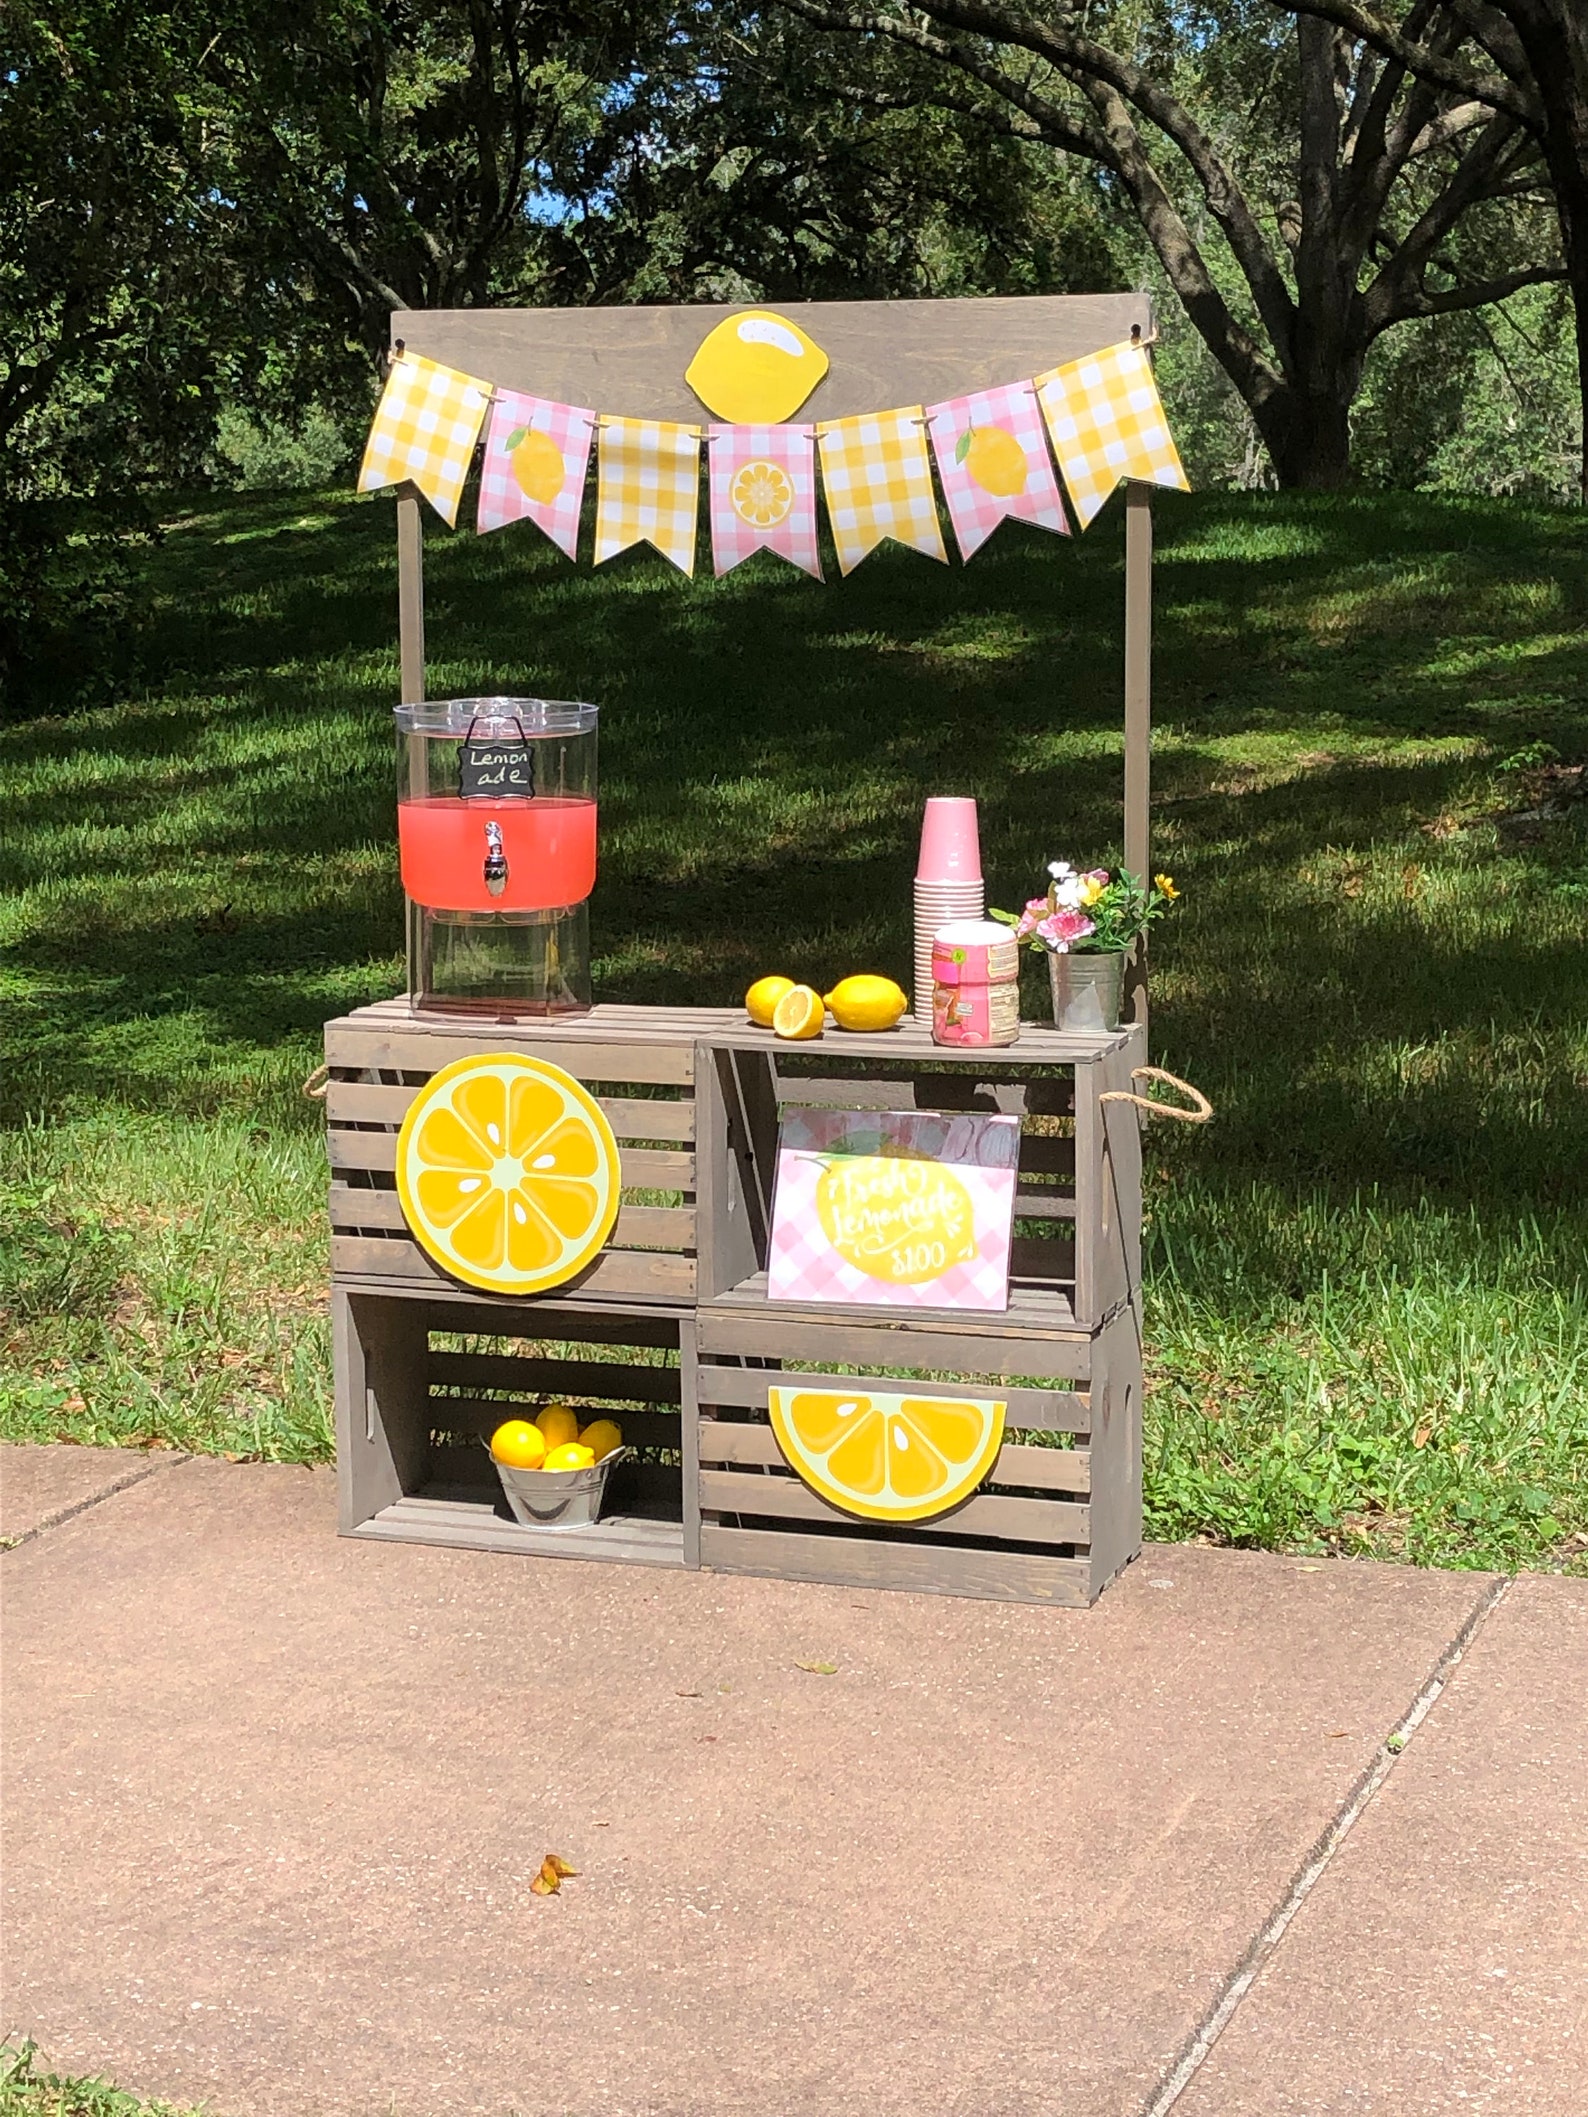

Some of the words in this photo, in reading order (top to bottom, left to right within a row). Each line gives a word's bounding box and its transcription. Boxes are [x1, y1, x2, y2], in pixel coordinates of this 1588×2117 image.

[470, 751, 528, 766] Lemon
[477, 766, 528, 786] ade
[833, 1180, 962, 1248] Lemonade
